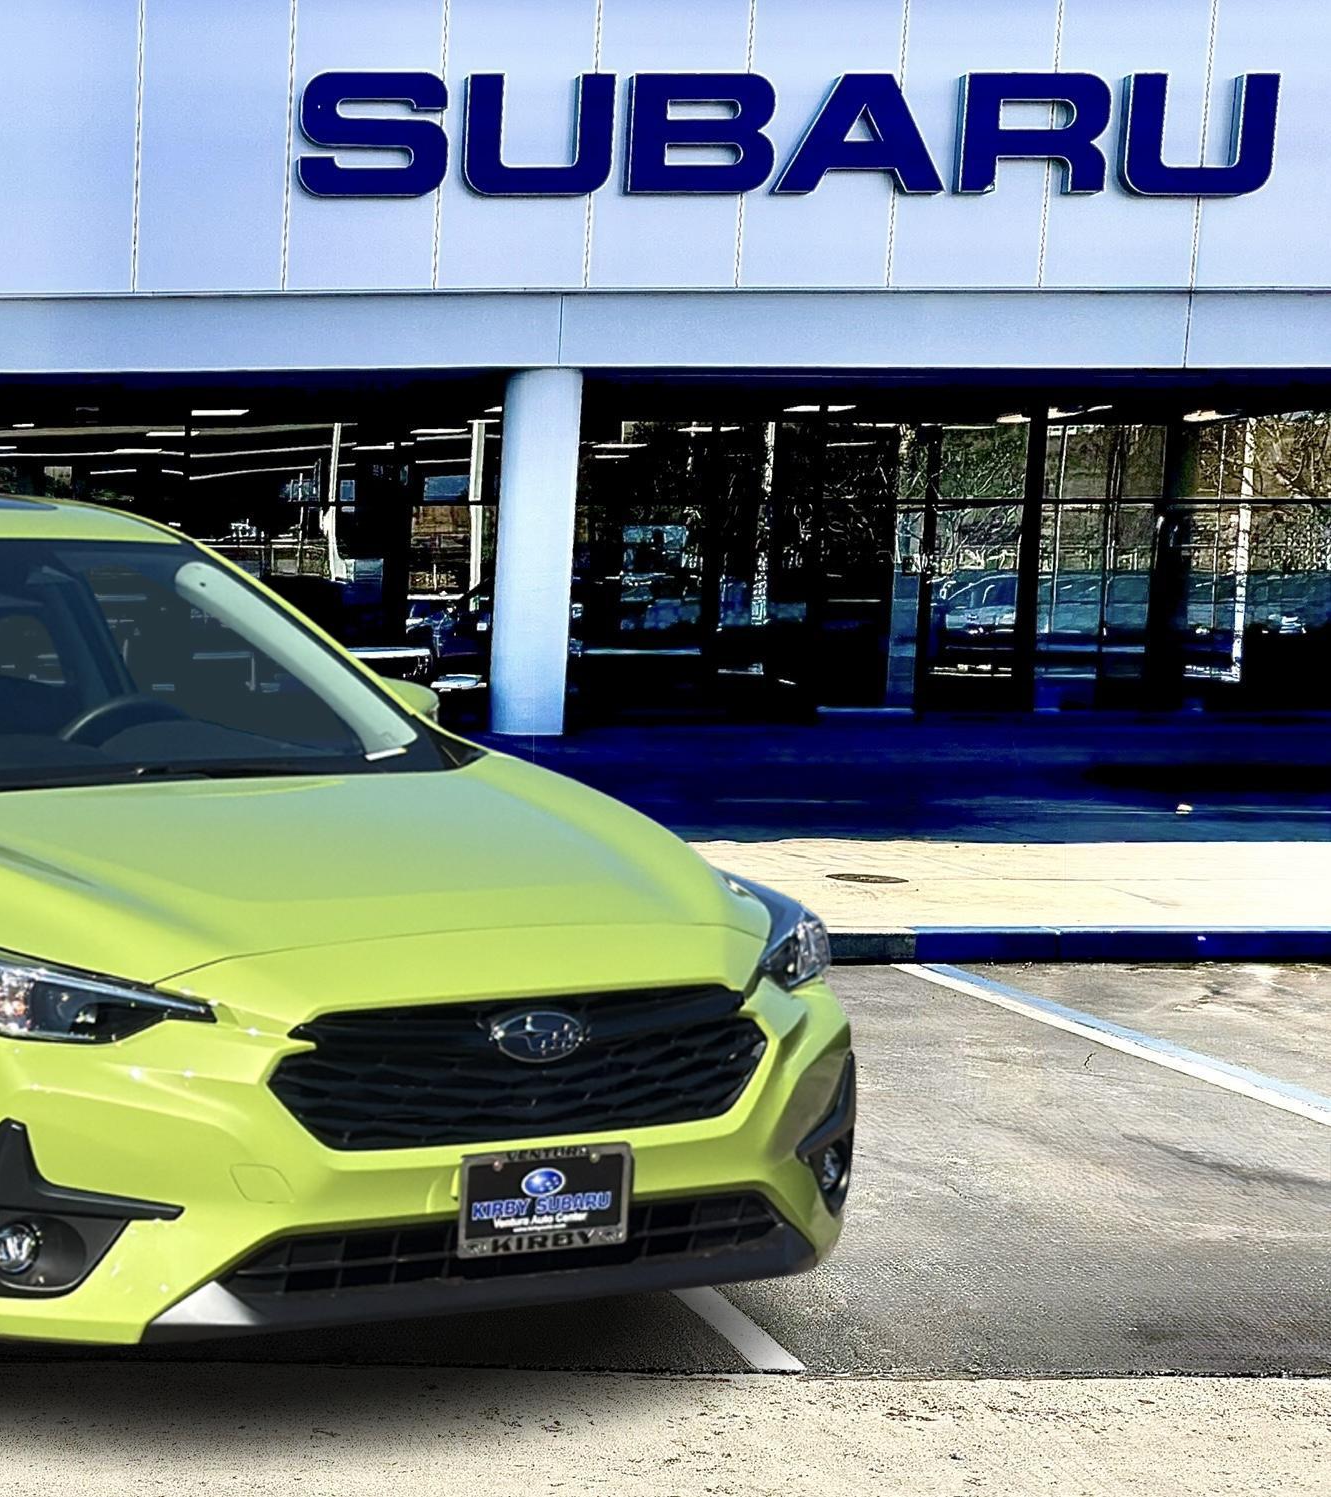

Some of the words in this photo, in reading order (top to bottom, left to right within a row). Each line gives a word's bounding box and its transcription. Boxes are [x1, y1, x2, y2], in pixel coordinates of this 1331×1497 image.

[296, 71, 1281, 197] SUBARU
[472, 1198, 530, 1221] KIRBY
[535, 1191, 612, 1214] SUBARU
[531, 1214, 554, 1225] Auto
[555, 1211, 589, 1223] Center
[491, 1230, 595, 1253] KIRBY
